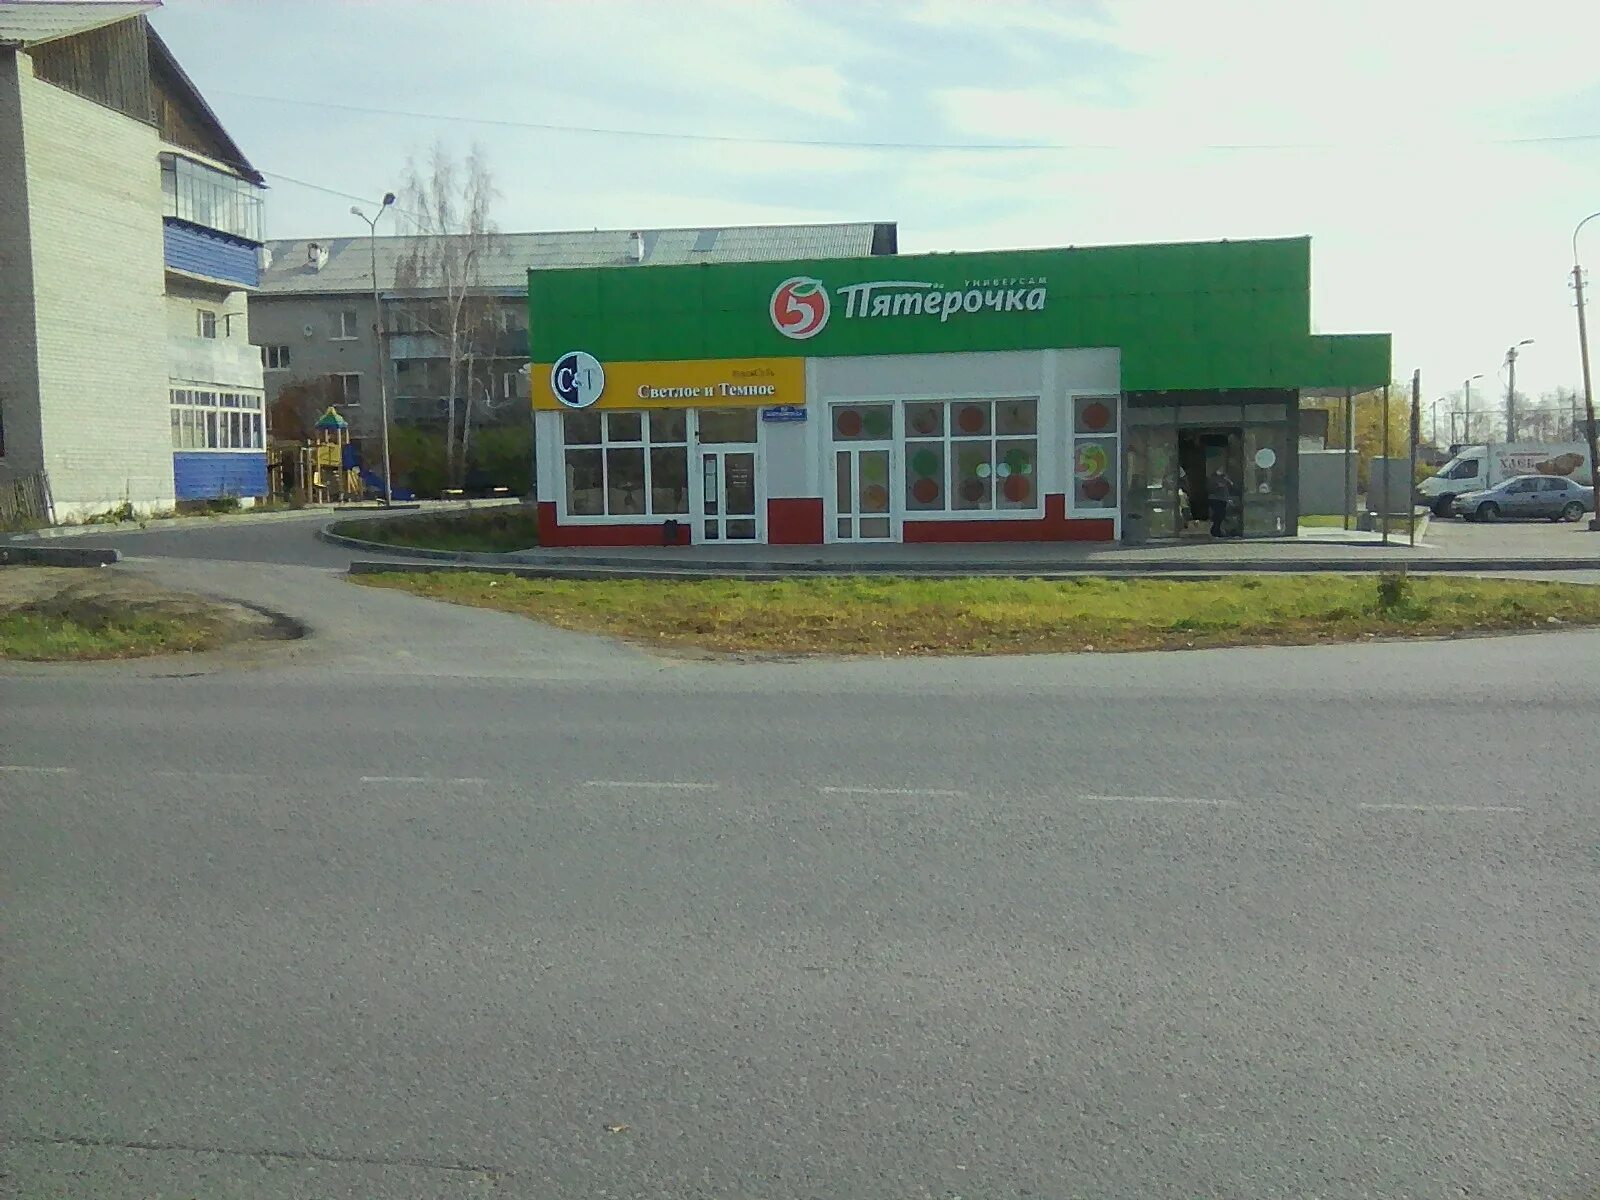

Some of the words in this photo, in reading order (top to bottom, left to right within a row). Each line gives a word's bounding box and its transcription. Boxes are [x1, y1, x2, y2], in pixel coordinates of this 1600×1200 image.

[964, 276, 1049, 287] УНИВЕРСАМ
[637, 384, 700, 399] Светлое
[704, 386, 714, 397] и
[718, 382, 775, 397] Темное
